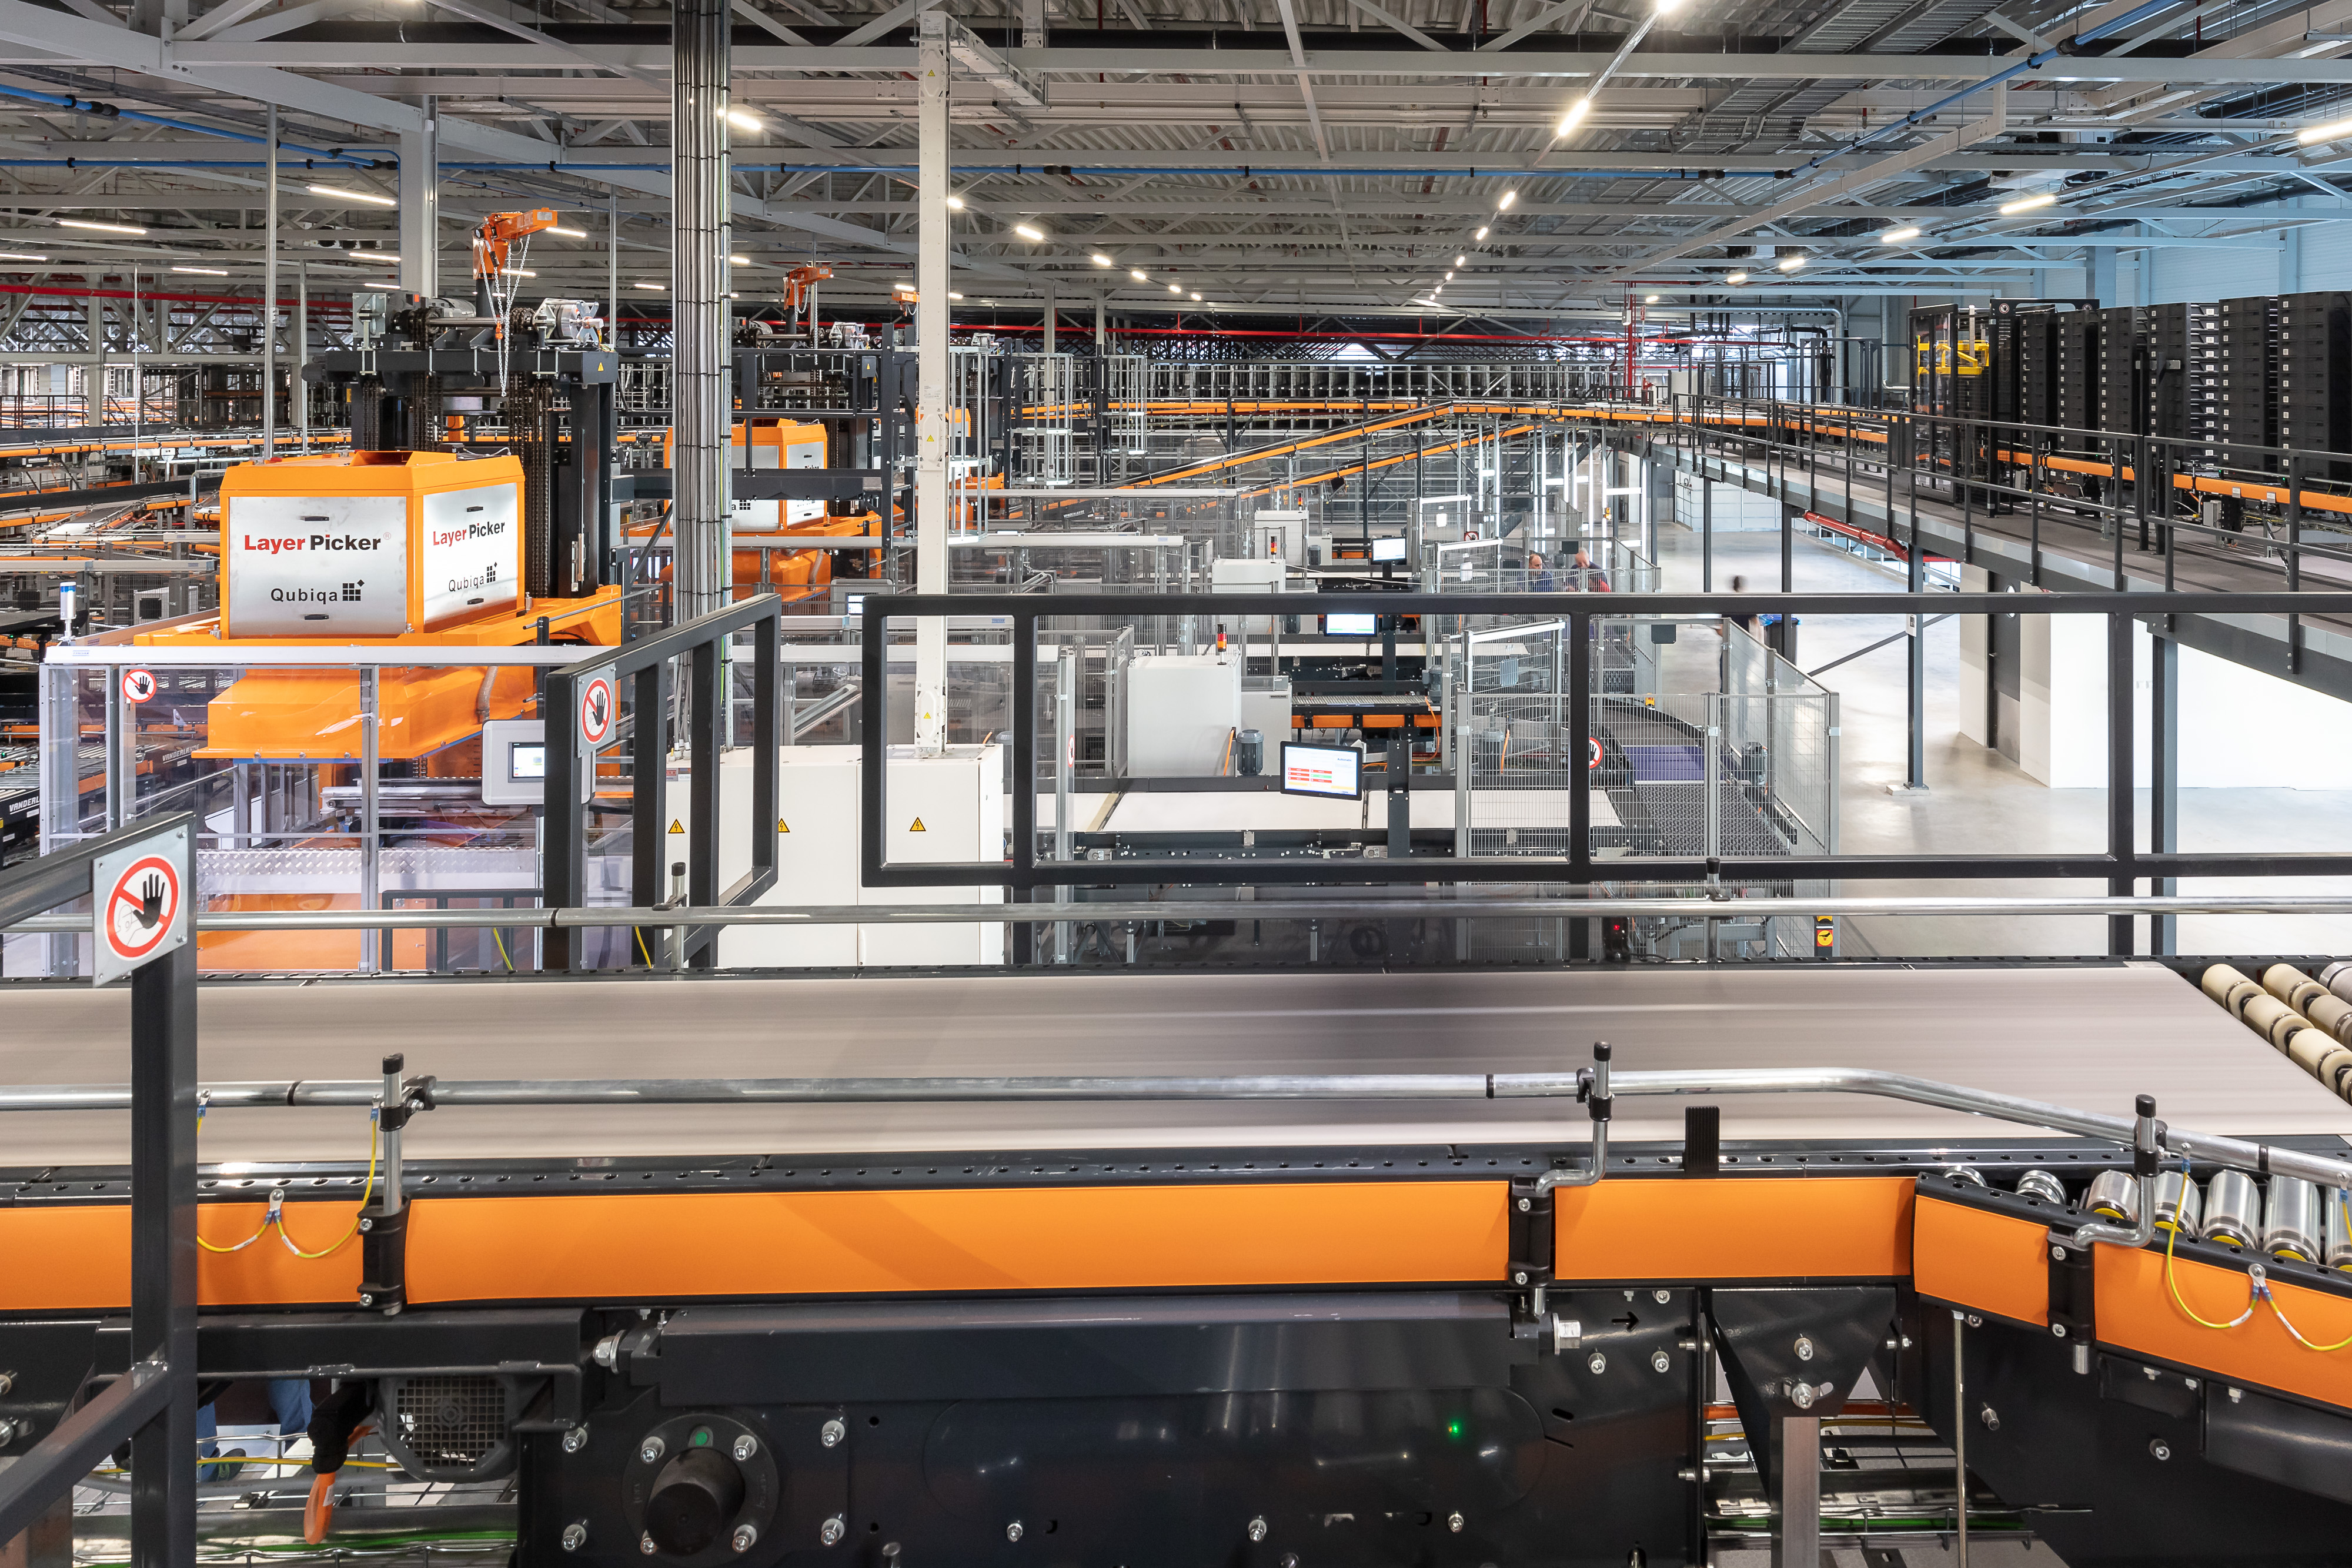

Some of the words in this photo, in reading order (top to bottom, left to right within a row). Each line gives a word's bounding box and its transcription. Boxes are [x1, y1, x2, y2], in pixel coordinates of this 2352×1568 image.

[433, 529, 466, 547] Layer
[469, 521, 505, 539] Picker
[244, 534, 306, 554] Layer
[449, 576, 485, 592] Qubiqa
[270, 588, 338, 604] Qubiqa
